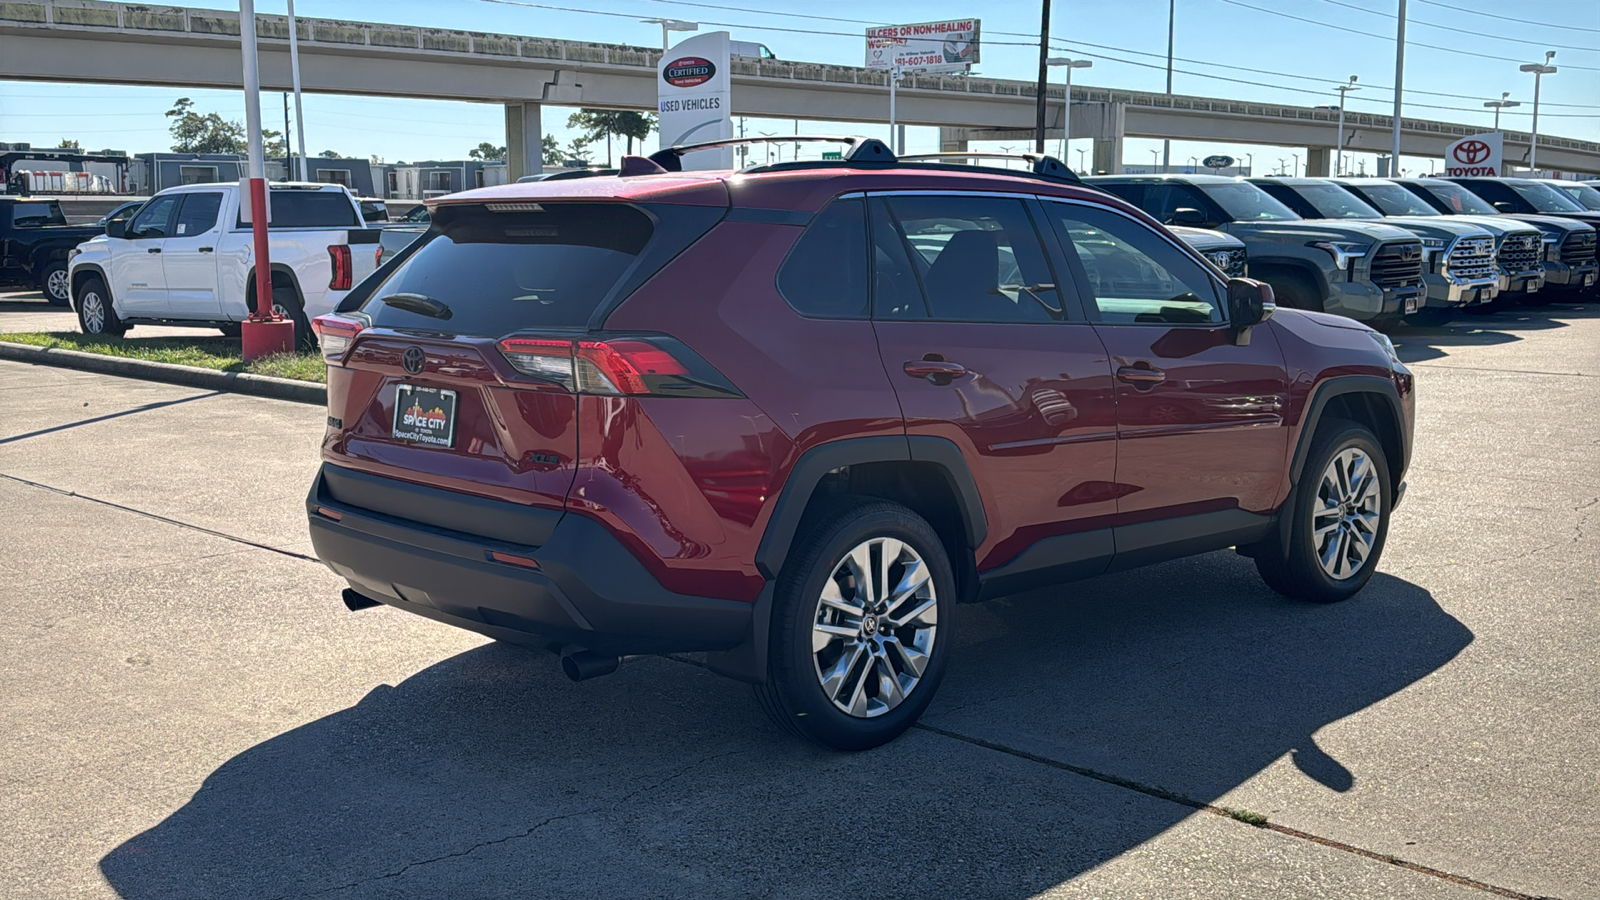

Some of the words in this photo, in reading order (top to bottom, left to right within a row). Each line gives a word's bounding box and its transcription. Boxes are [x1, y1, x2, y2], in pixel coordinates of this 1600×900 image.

[867, 28, 898, 39] ULCERS
[899, 25, 912, 36] OR
[913, 21, 973, 35] NON-HEALING
[668, 66, 708, 77] CERTIFIED
[660, 100, 680, 113] USED
[681, 97, 720, 111] VEHICLES
[1207, 157, 1229, 167] Ford
[1446, 166, 1497, 177] TOYOTA
[403, 414, 427, 428] SPACE
[428, 418, 446, 430] CITY
[395, 429, 449, 445] SpaceCityToyota.com
